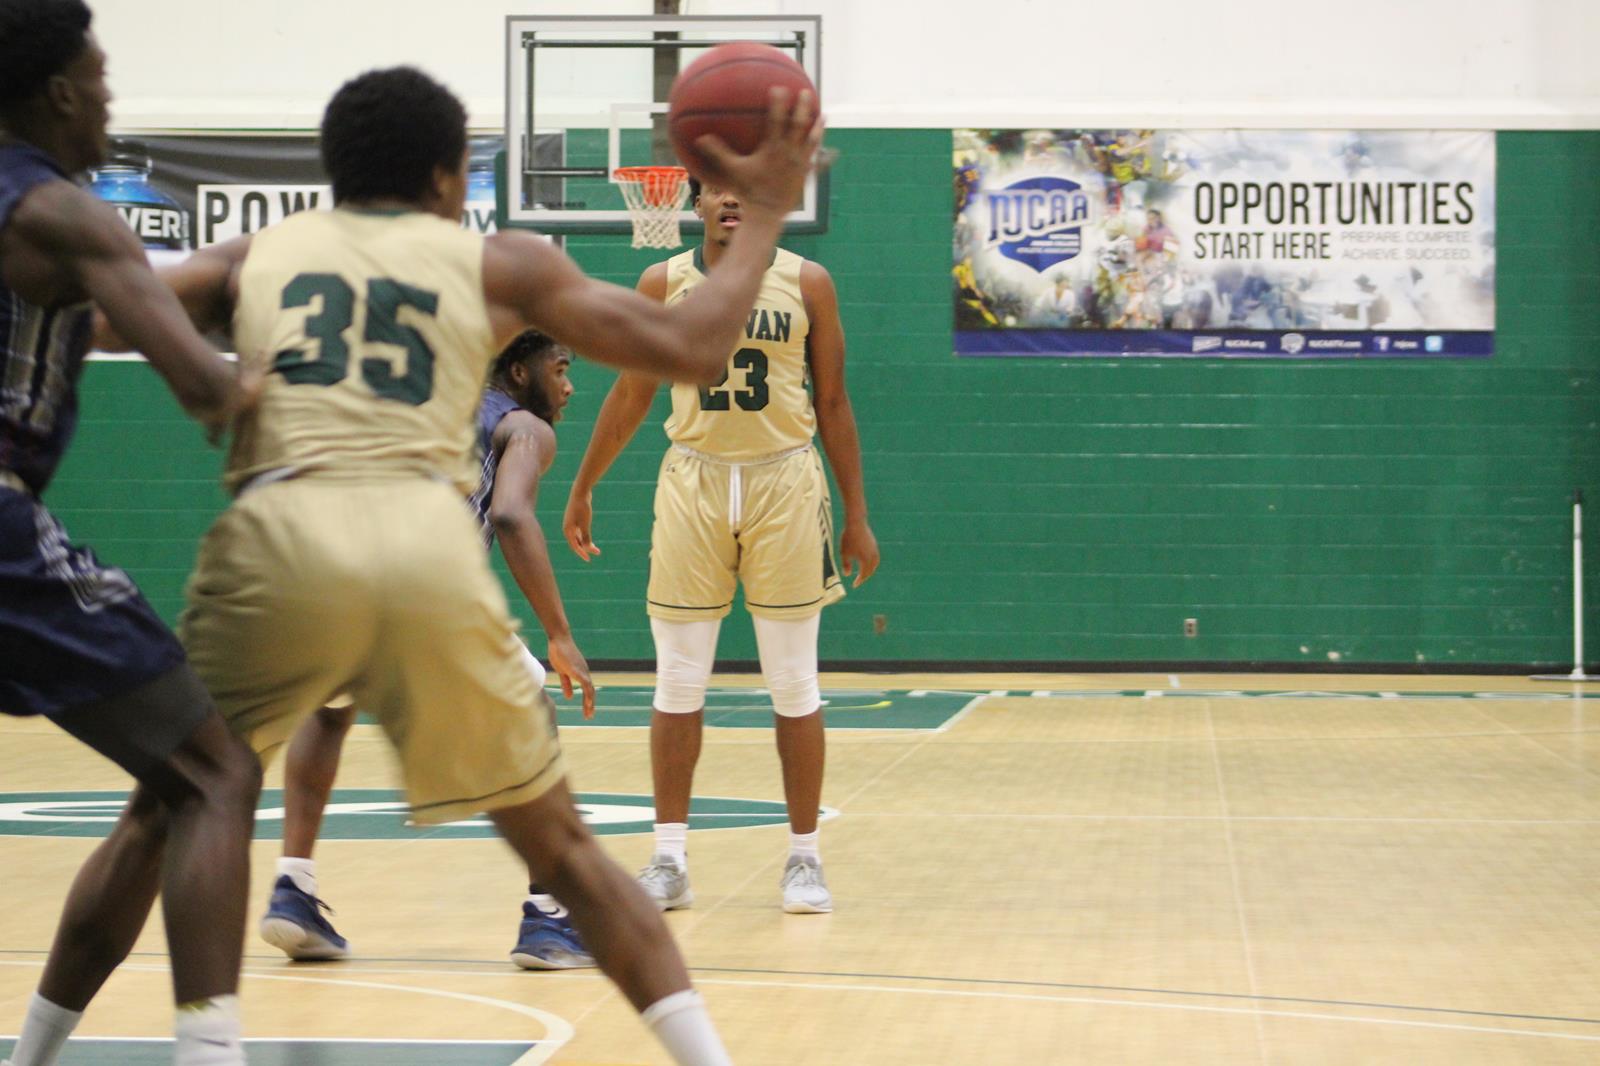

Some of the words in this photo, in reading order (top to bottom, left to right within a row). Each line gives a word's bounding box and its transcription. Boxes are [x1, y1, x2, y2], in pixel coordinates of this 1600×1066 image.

[986, 191, 1089, 242] NJCAA
[1194, 181, 1474, 225] OPPORTUNITIES
[1194, 231, 1264, 260] START
[1272, 231, 1332, 260] HERE
[268, 272, 440, 406] 35
